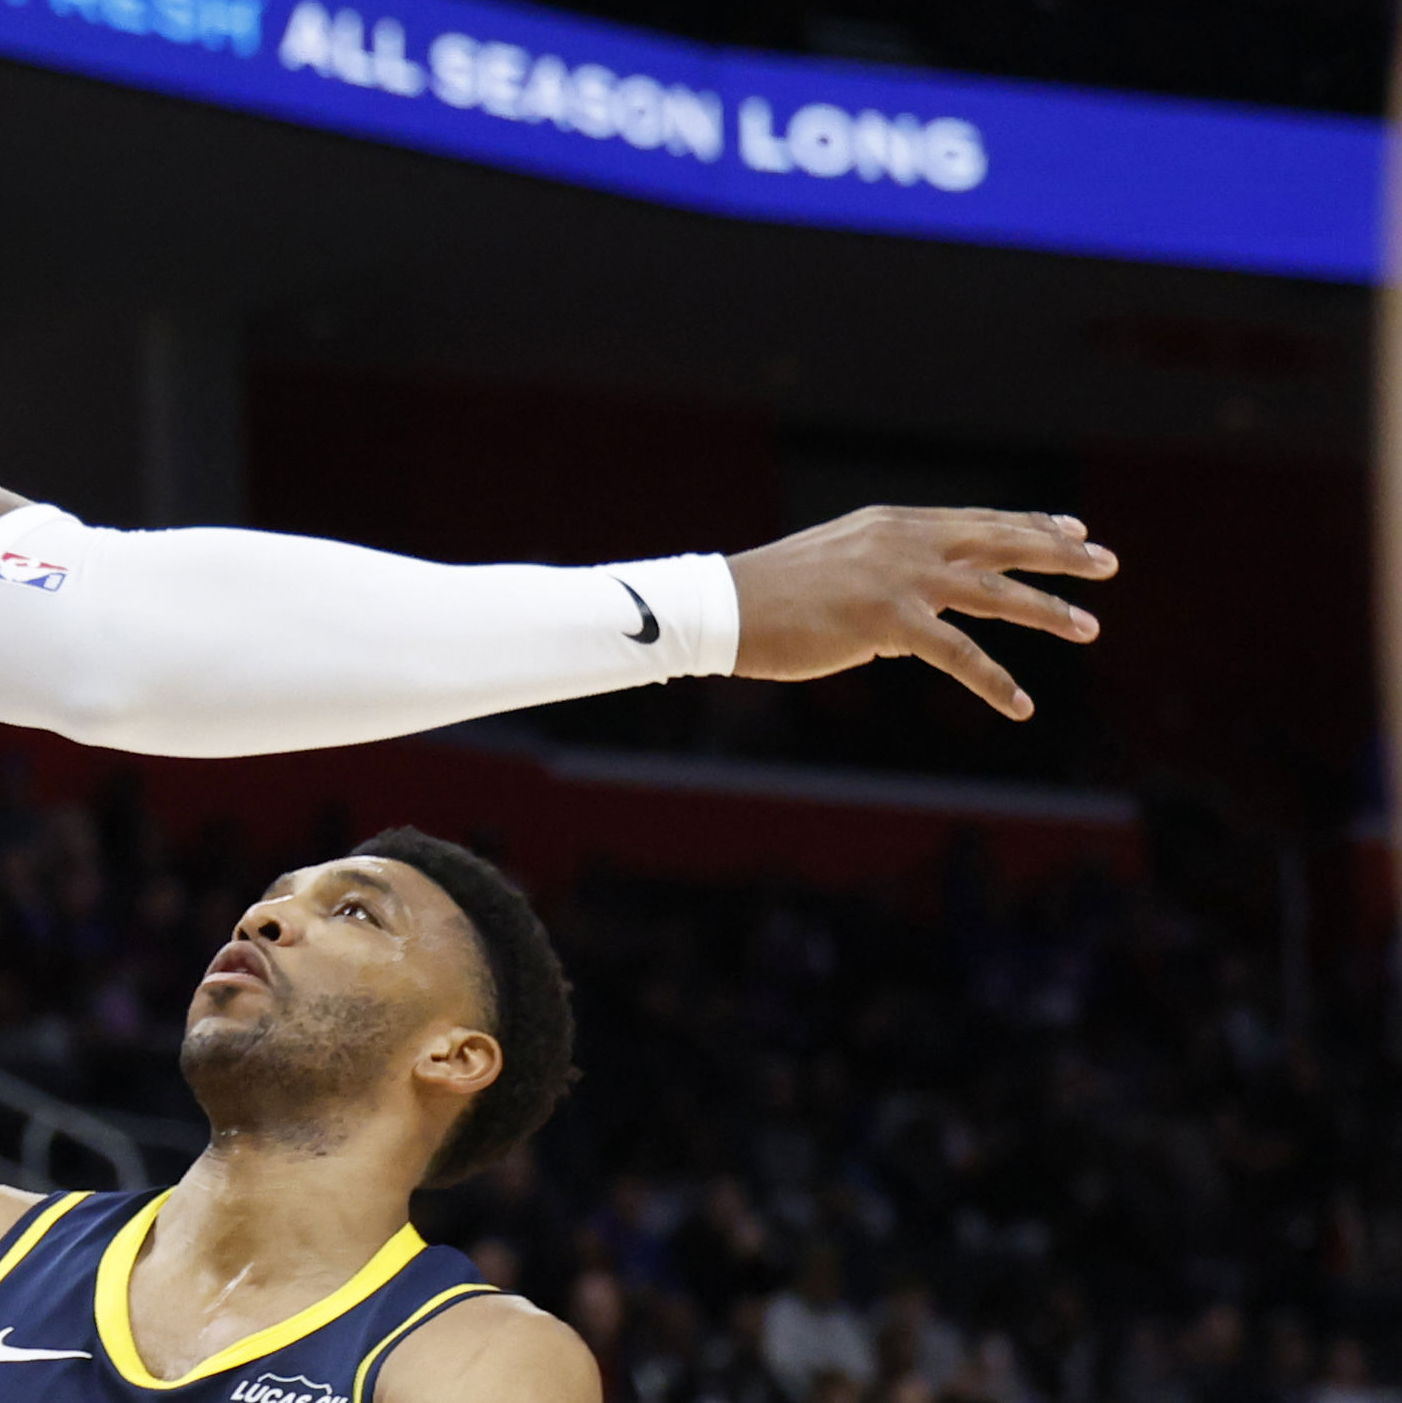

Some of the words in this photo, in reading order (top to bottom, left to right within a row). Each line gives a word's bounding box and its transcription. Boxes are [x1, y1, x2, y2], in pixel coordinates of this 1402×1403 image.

[278, 0, 428, 97] ALL
[429, 32, 725, 162] SEASON
[738, 96, 988, 192] LONG
